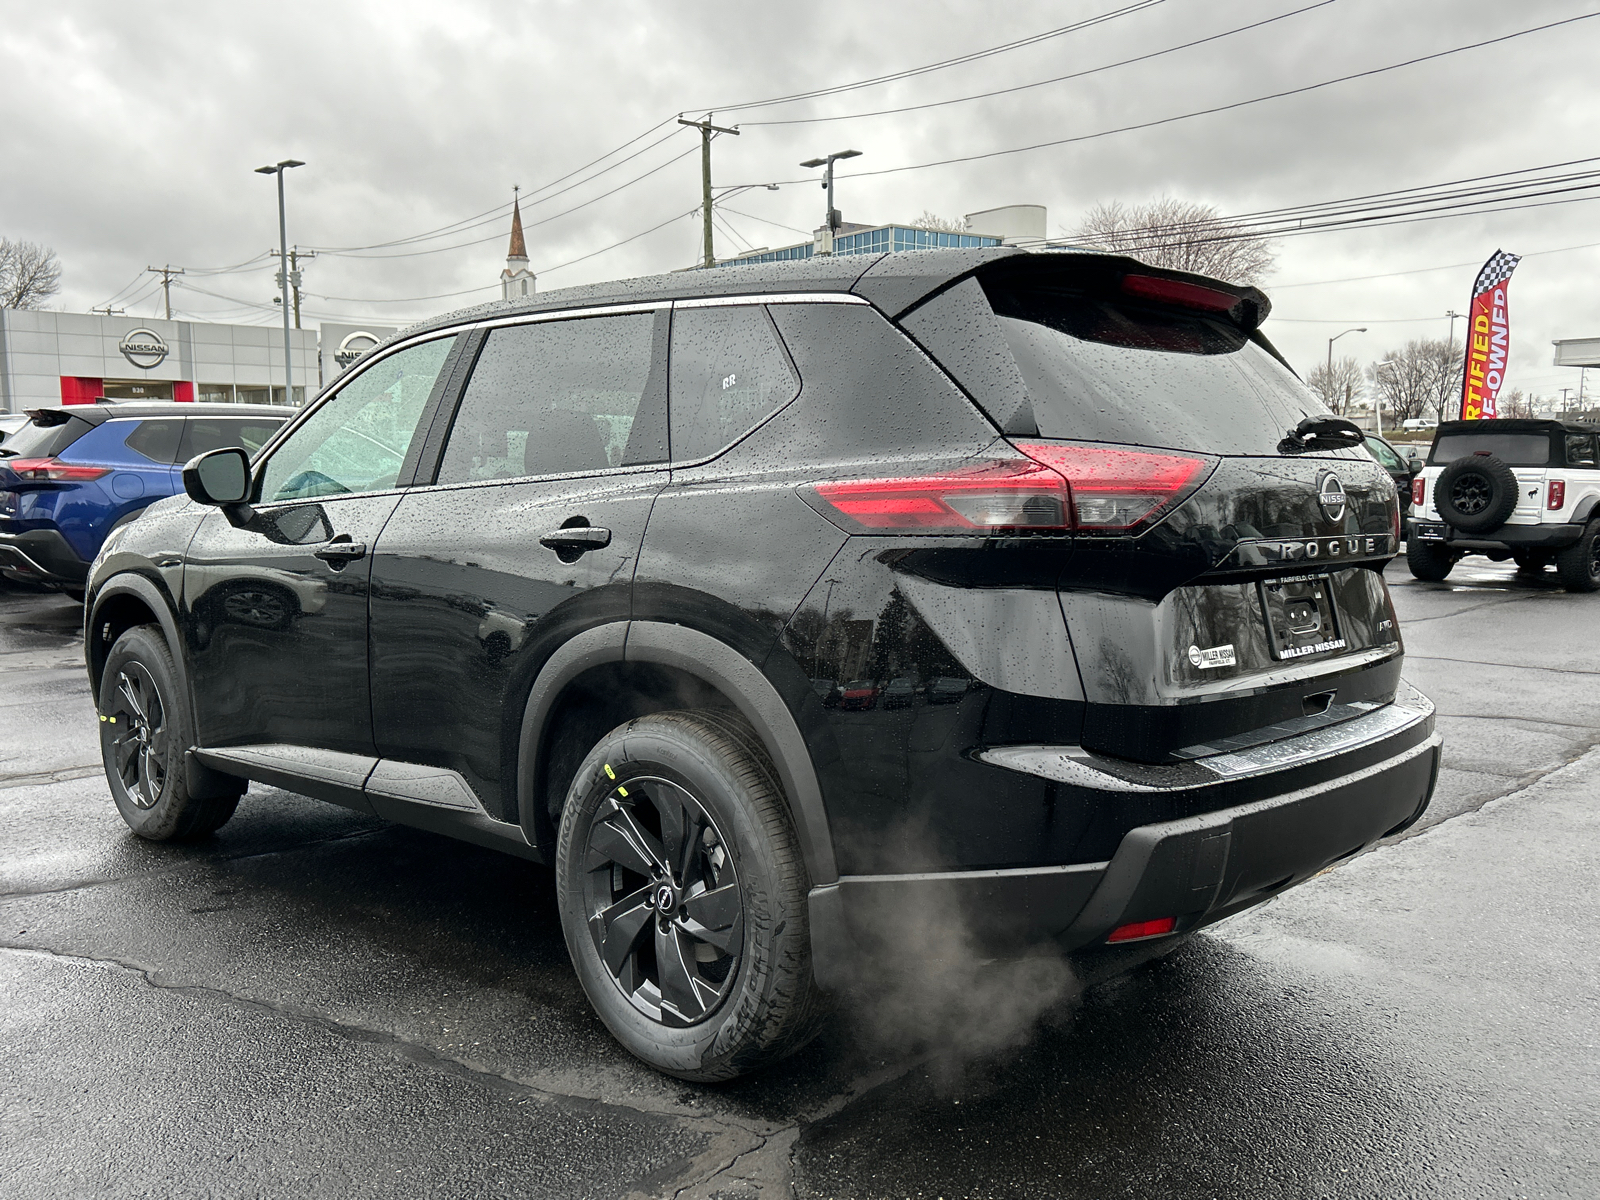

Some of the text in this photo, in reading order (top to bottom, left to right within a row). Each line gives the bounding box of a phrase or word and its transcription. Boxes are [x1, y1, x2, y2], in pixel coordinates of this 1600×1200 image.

[125, 343, 165, 352] NISSAN
[341, 351, 362, 360] NIS
[1482, 288, 1508, 420] E-OWNED
[1466, 315, 1489, 420] RTIFIED
[722, 373, 736, 390] RR
[1280, 538, 1375, 560] ROGUE
[1201, 648, 1235, 661] MILLER NISSAN
[1279, 639, 1346, 659] MILLER NISSAN
